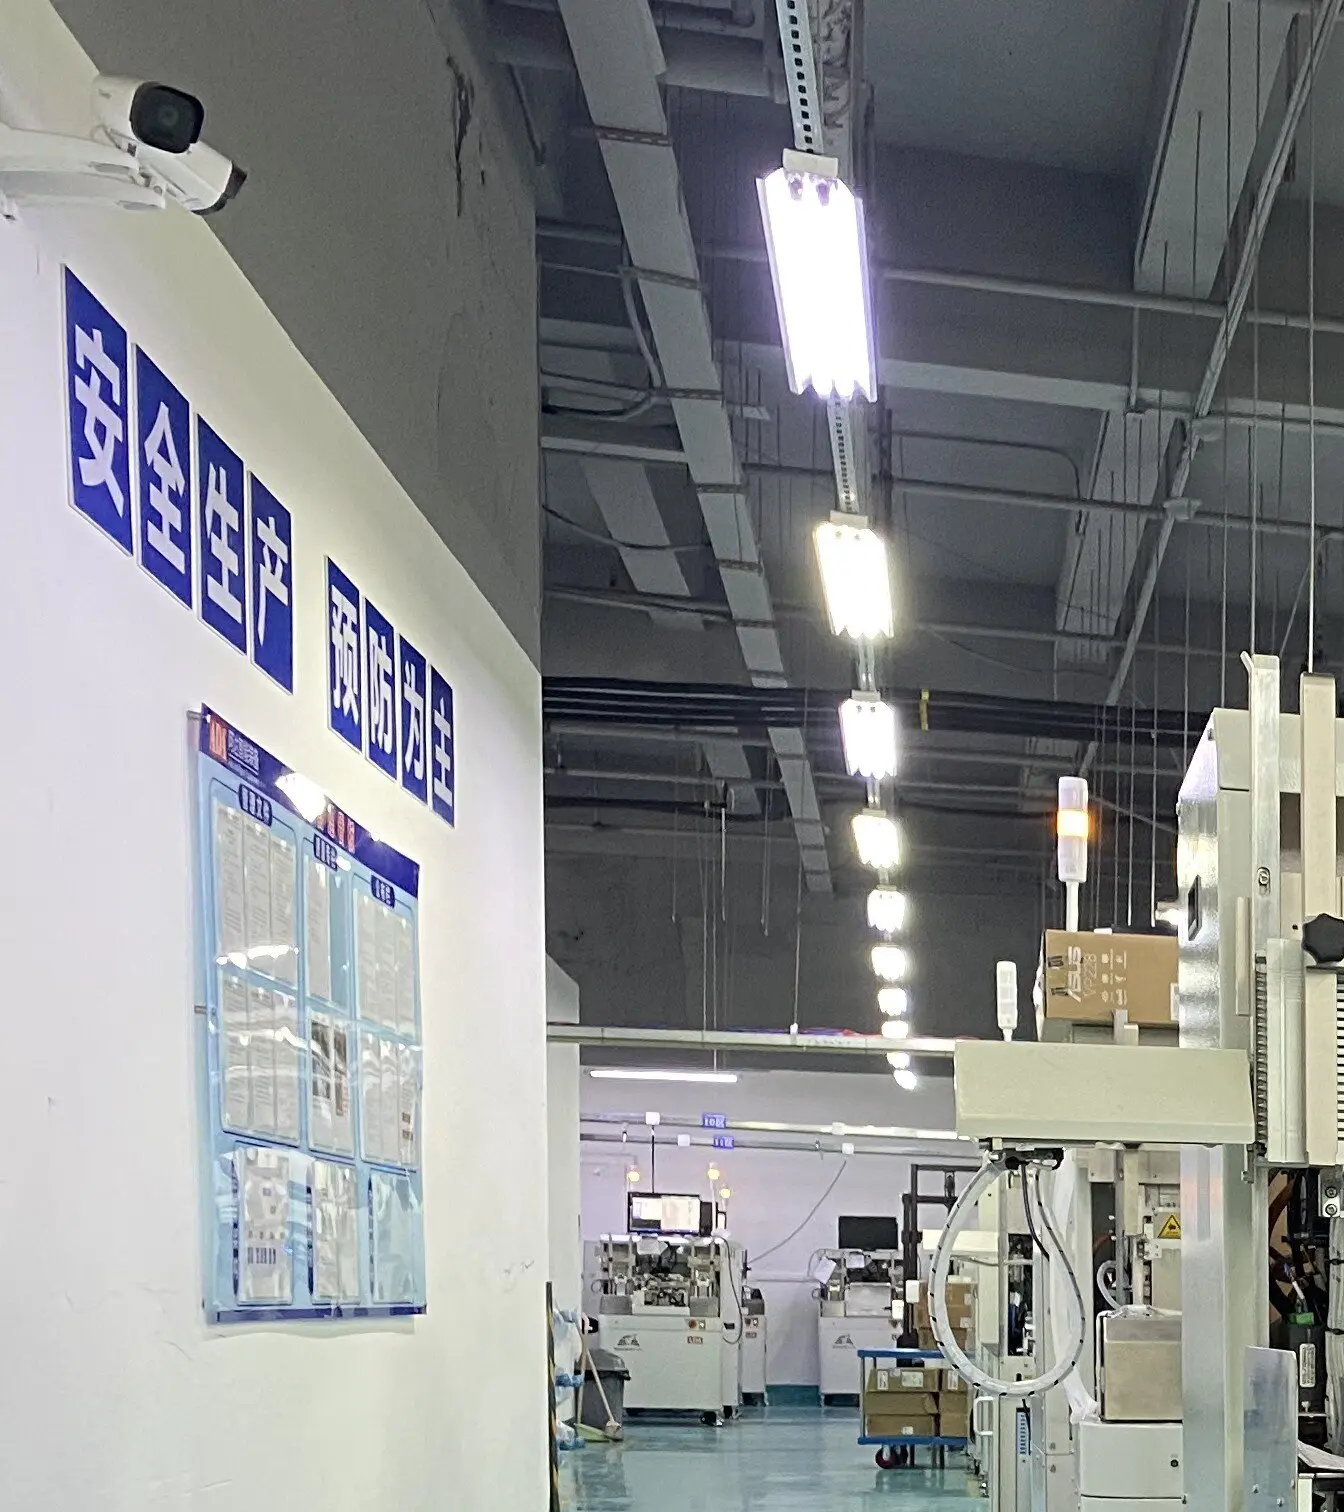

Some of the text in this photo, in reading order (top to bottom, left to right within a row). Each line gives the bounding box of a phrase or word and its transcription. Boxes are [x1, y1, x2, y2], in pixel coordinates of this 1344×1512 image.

[75, 324, 452, 806] 安全生产 预防为主
[1067, 946, 1082, 1003] ASUS
